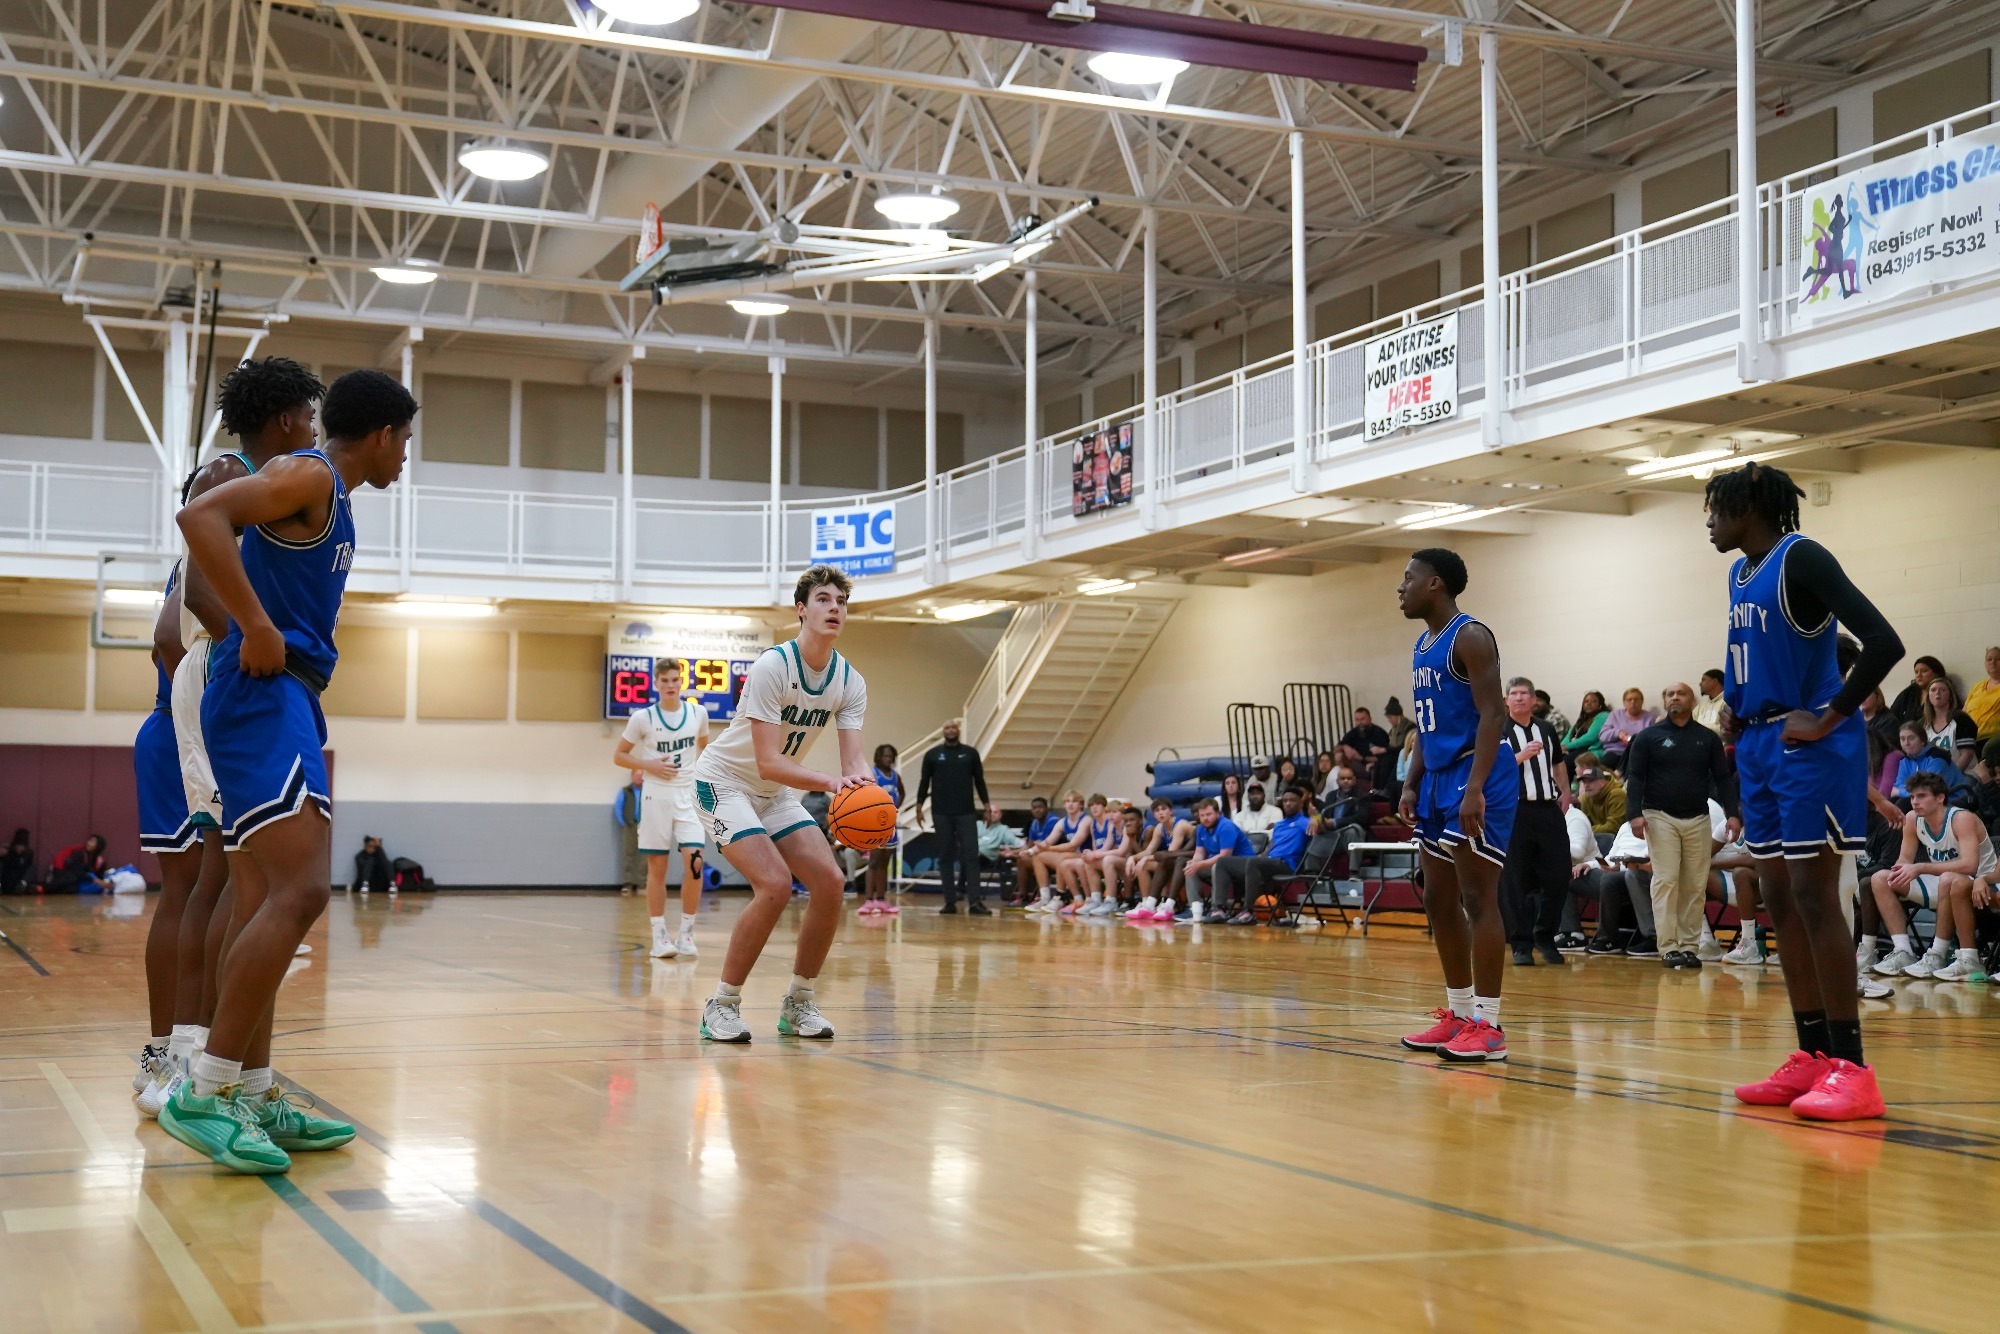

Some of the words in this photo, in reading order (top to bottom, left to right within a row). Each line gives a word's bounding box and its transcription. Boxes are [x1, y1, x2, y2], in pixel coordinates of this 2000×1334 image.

[1865, 160, 1958, 216] Fitness
[1867, 222, 1934, 256] Register
[1941, 205, 1982, 233] Now!
[1866, 232, 1986, 284] (843)915-5332
[1378, 324, 1443, 363] ADVERTISE
[1367, 364, 1396, 391] YOUR
[1400, 344, 1455, 379] BUSINESS
[1387, 375, 1431, 412] HERE
[816, 509, 892, 550] HTC
[727, 630, 759, 642] Forest
[612, 657, 650, 672] HOME
[615, 671, 649, 703] 62
[1416, 698, 1436, 733] 23
[781, 731, 806, 756] 11
